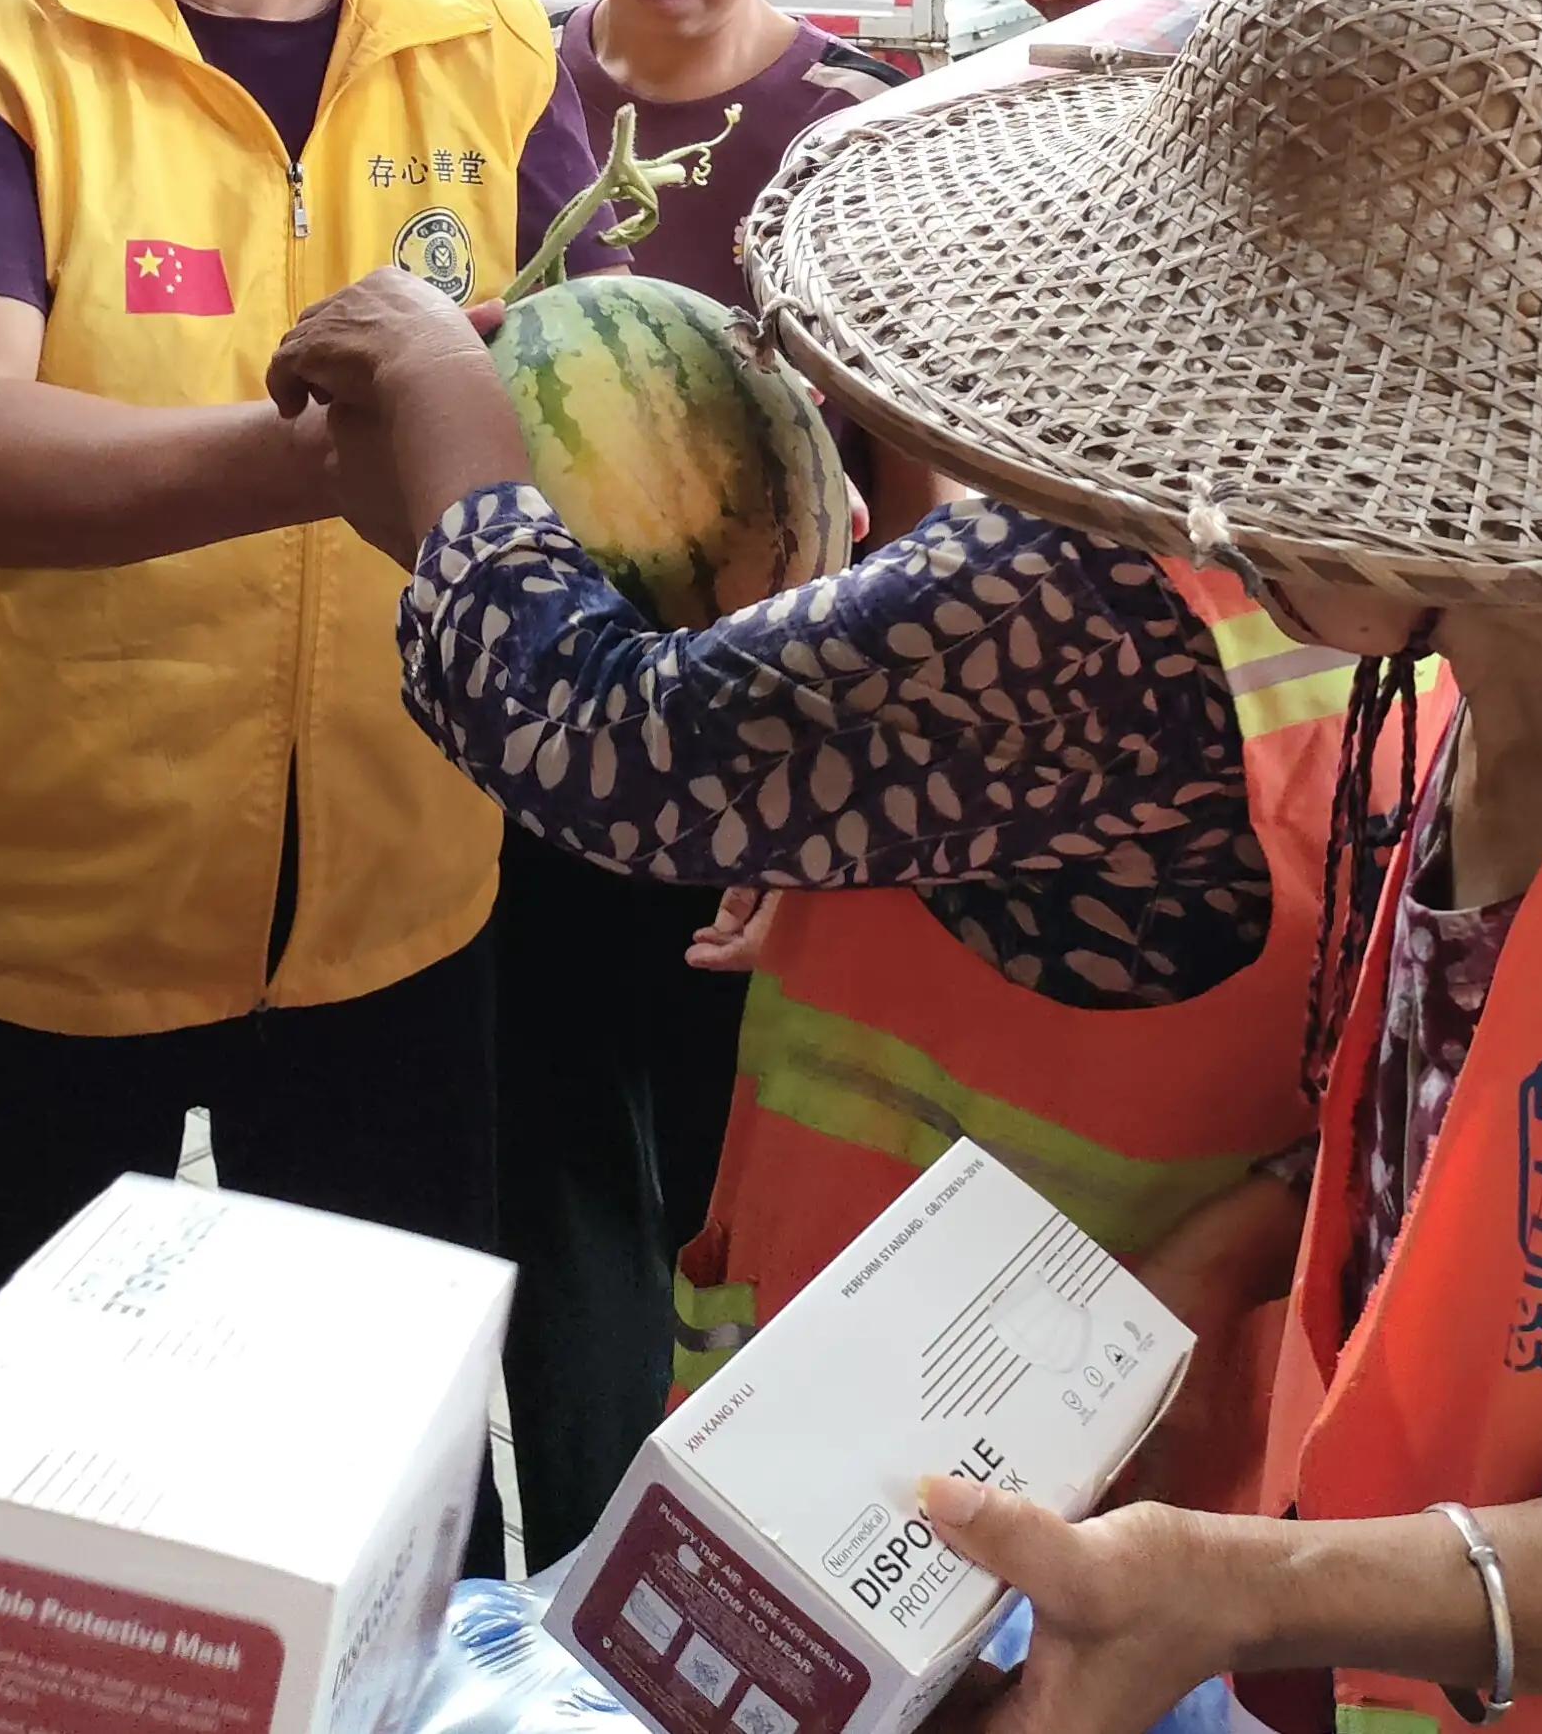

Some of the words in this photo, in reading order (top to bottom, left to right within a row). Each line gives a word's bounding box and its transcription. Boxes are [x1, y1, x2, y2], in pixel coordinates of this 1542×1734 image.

[367, 149, 488, 188] 存心善堂
[841, 1257, 884, 1299] PERFORM
[684, 1431, 707, 1454] XIN
[701, 1404, 735, 1436] KANG
[729, 1393, 746, 1409] XI
[740, 1383, 756, 1398] LI
[827, 1509, 885, 1571] Non-medical
[849, 1437, 1005, 1610] DISPOLE
[658, 1502, 699, 1544] PURIFY
[698, 1541, 724, 1566] THE
[748, 1586, 782, 1620] CARE
[780, 1614, 806, 1642] FOR
[805, 1639, 856, 1683] HEALTH
[708, 1577, 745, 1615] HOW
[747, 1613, 766, 1635] TO
[767, 1630, 815, 1675] WEAR
[38, 1596, 168, 1656] Protective
[171, 1628, 242, 1673] Mask
